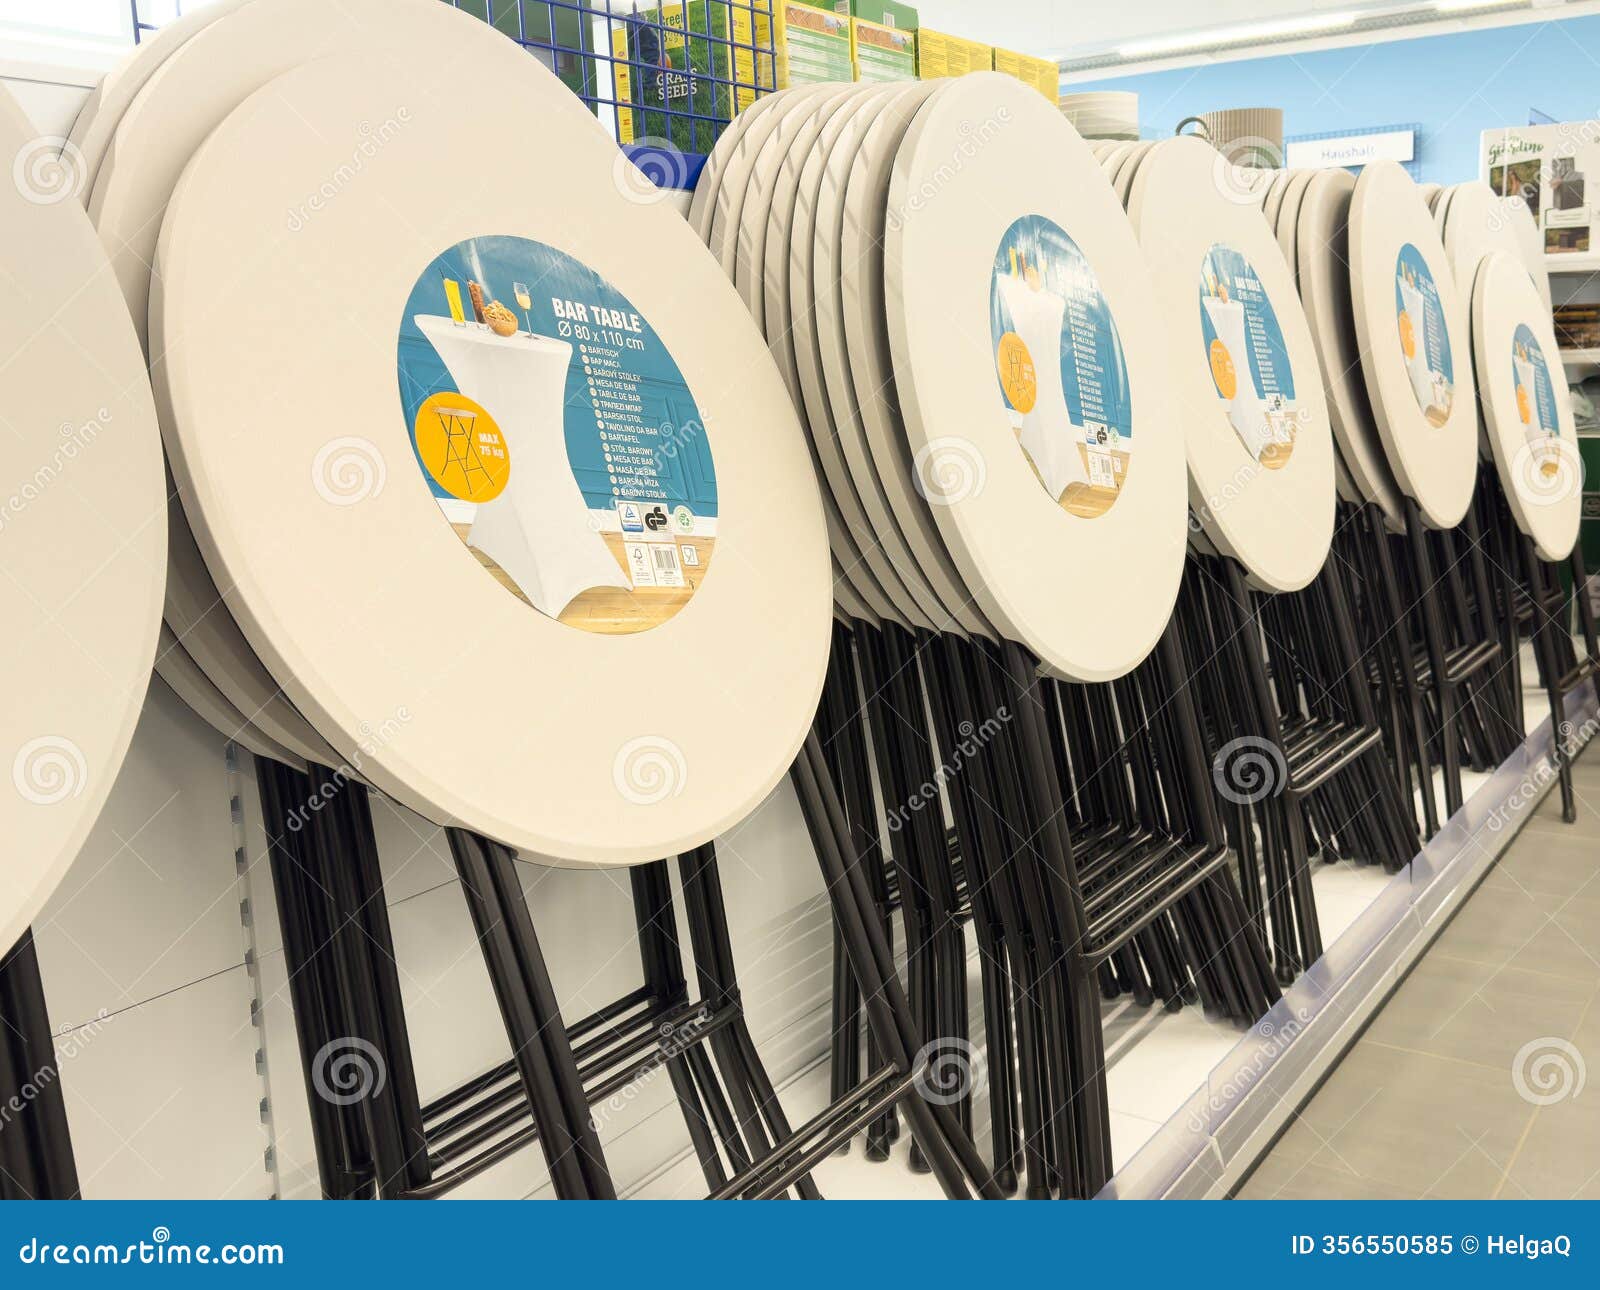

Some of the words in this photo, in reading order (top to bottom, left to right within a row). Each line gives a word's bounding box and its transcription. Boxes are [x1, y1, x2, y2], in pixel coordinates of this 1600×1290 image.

[656, 67, 697, 87] GRAS
[658, 82, 698, 101] SEEDS
[551, 297, 589, 323] BAR
[589, 305, 642, 333] TABLE
[574, 324, 591, 341] 80
[592, 331, 600, 343] x
[601, 330, 624, 347] 110
[625, 337, 645, 352] cm
[588, 346, 619, 357] BARTISCH
[595, 379, 613, 388] MESA
[613, 381, 623, 390] DE
[624, 383, 637, 392] BAR
[598, 389, 617, 399] TABLE
[619, 392, 627, 400] DE
[628, 394, 641, 402] BAR
[602, 411, 626, 420] BARSKI
[627, 414, 642, 423] STOL
[605, 421, 637, 433] TAVOLINO
[637, 426, 645, 434] DA
[645, 427, 658, 436] BAR
[479, 432, 500, 445] MAX
[608, 433, 640, 444] BARTAFEL
[479, 445, 491, 456] 75
[613, 454, 632, 464] MESA
[632, 457, 641, 465] DE
[641, 458, 654, 466] BAR
[634, 467, 643, 475] DE
[644, 468, 657, 476] BAR
